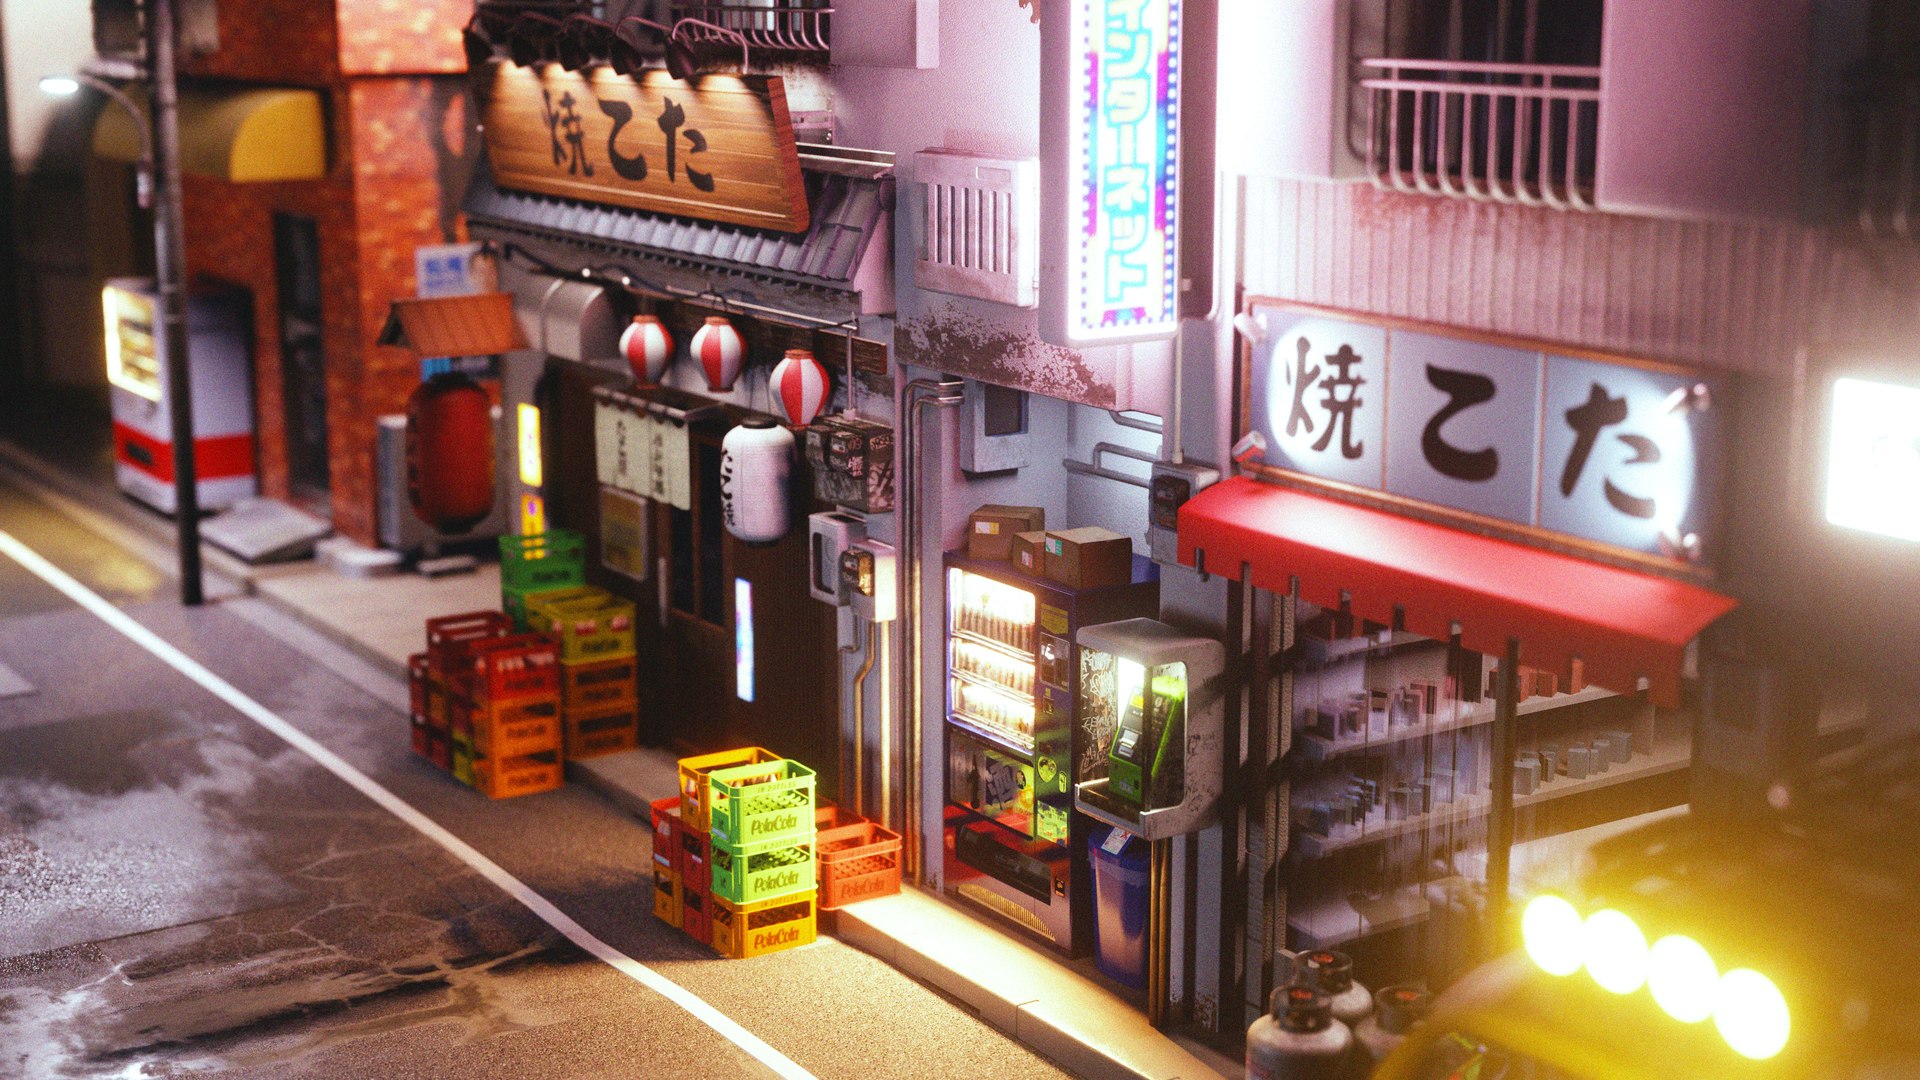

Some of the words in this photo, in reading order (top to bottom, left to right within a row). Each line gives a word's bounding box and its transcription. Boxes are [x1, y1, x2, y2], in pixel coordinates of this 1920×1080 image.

[751, 814, 798, 835] PolaCola
[754, 870, 800, 893] PolaCola
[754, 926, 800, 949] PolaCola
